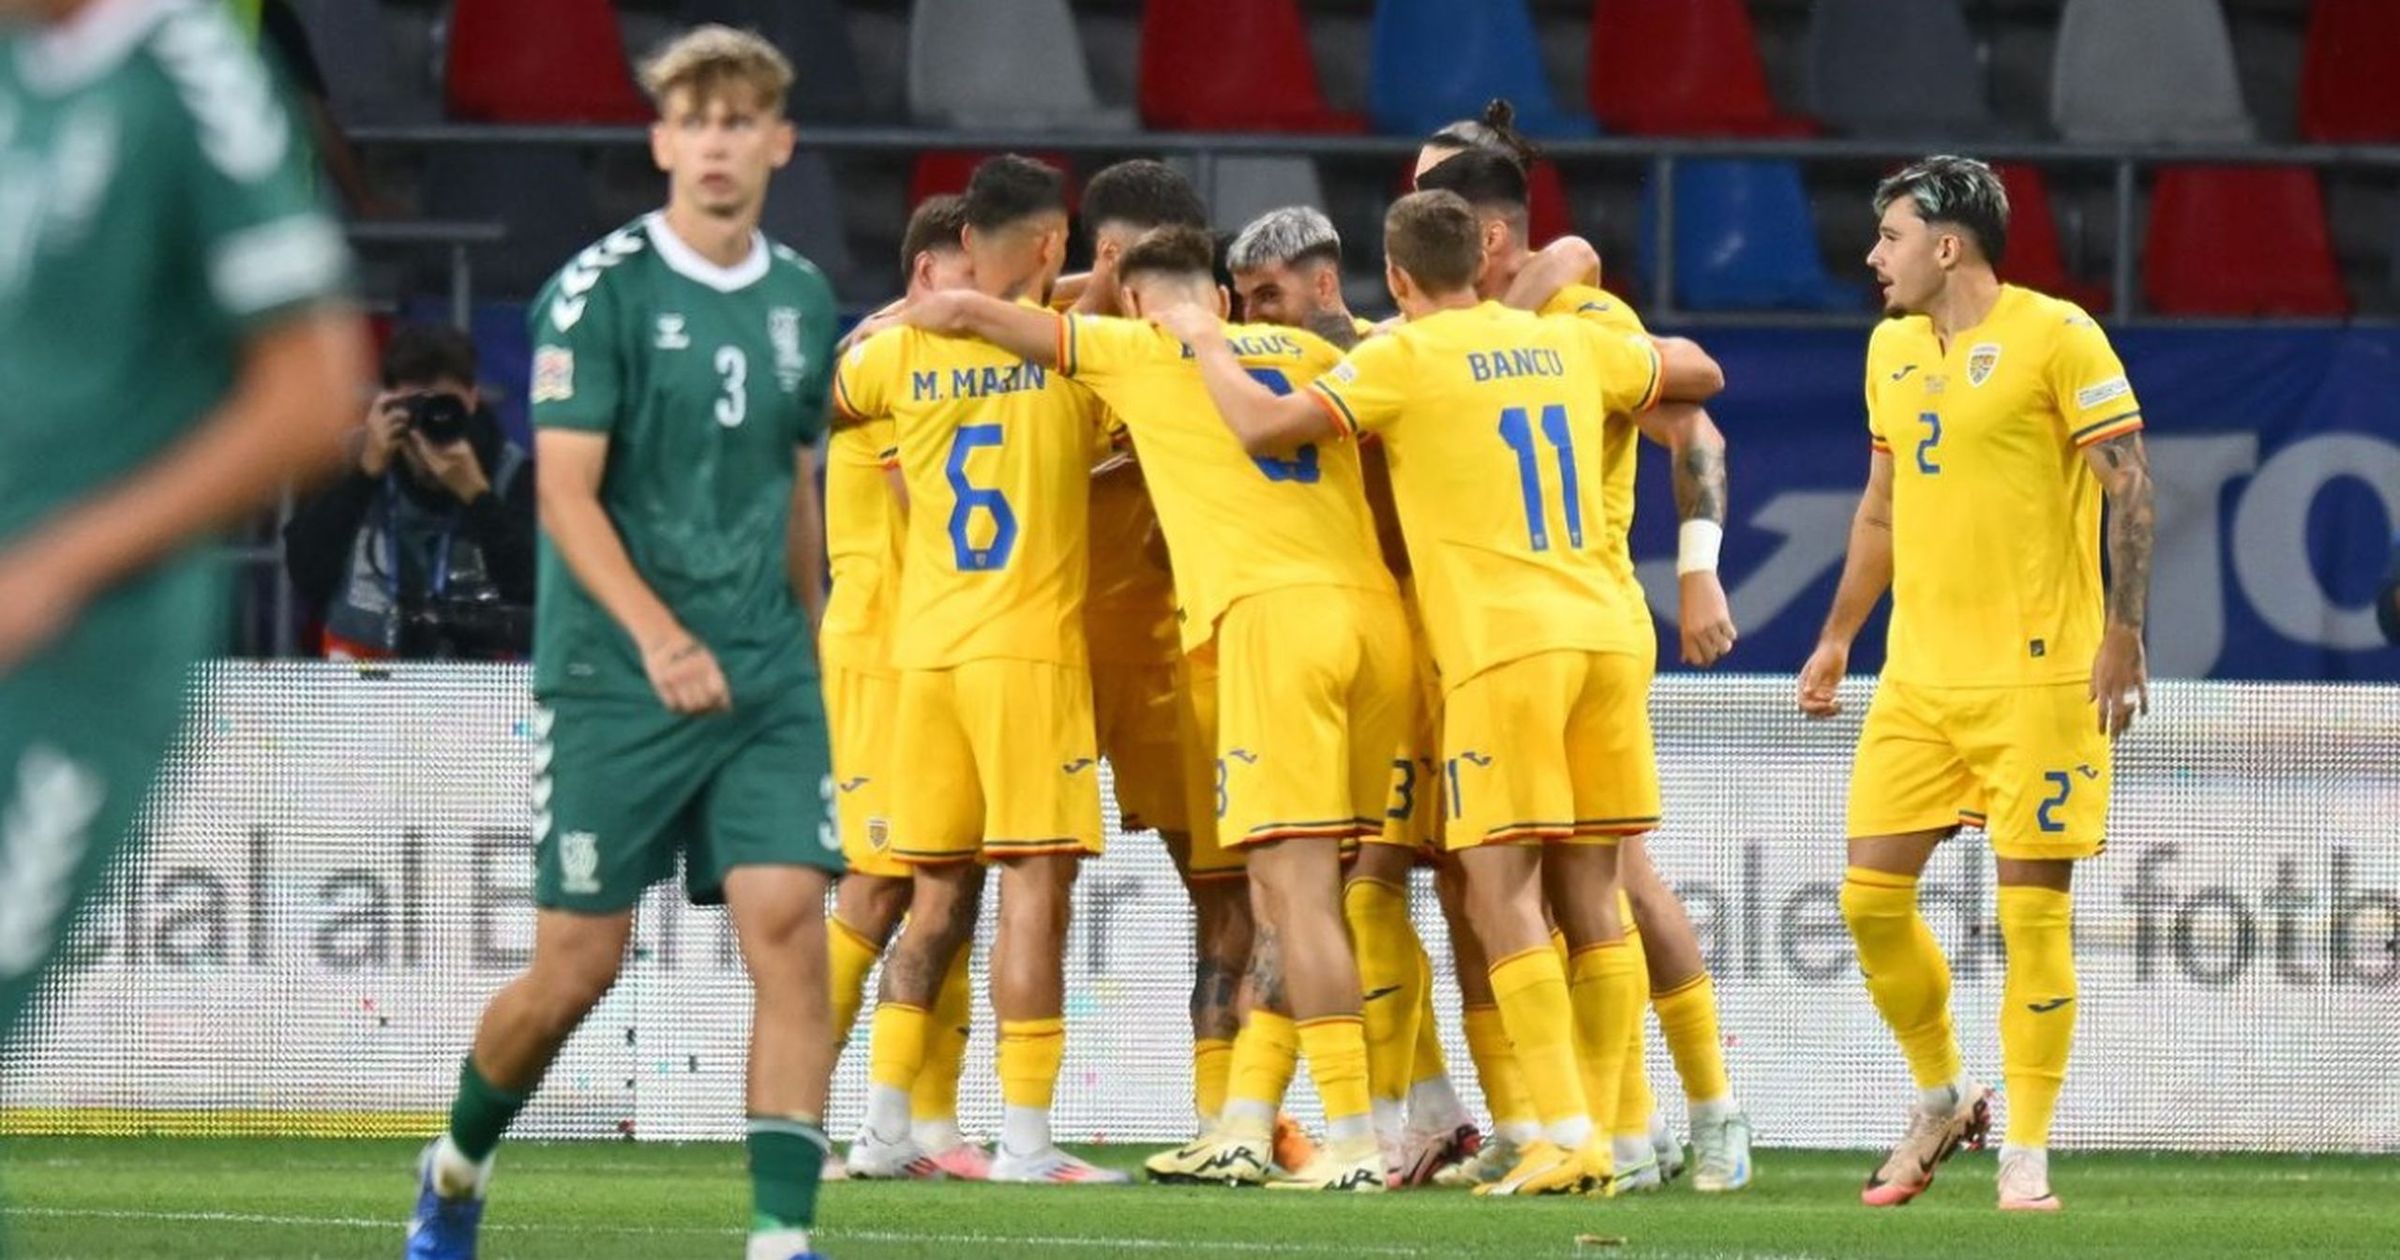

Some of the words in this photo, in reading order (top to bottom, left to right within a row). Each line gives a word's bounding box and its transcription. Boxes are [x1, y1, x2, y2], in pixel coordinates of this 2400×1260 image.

[714, 345, 747, 427] 3
[913, 370, 943, 401] M.
[1467, 348, 1565, 382] BANCU
[1916, 412, 1942, 474] 2
[945, 423, 1019, 572] 6
[1498, 404, 1582, 552] 11
[1386, 759, 1416, 820] 3
[2037, 771, 2071, 832] 2
